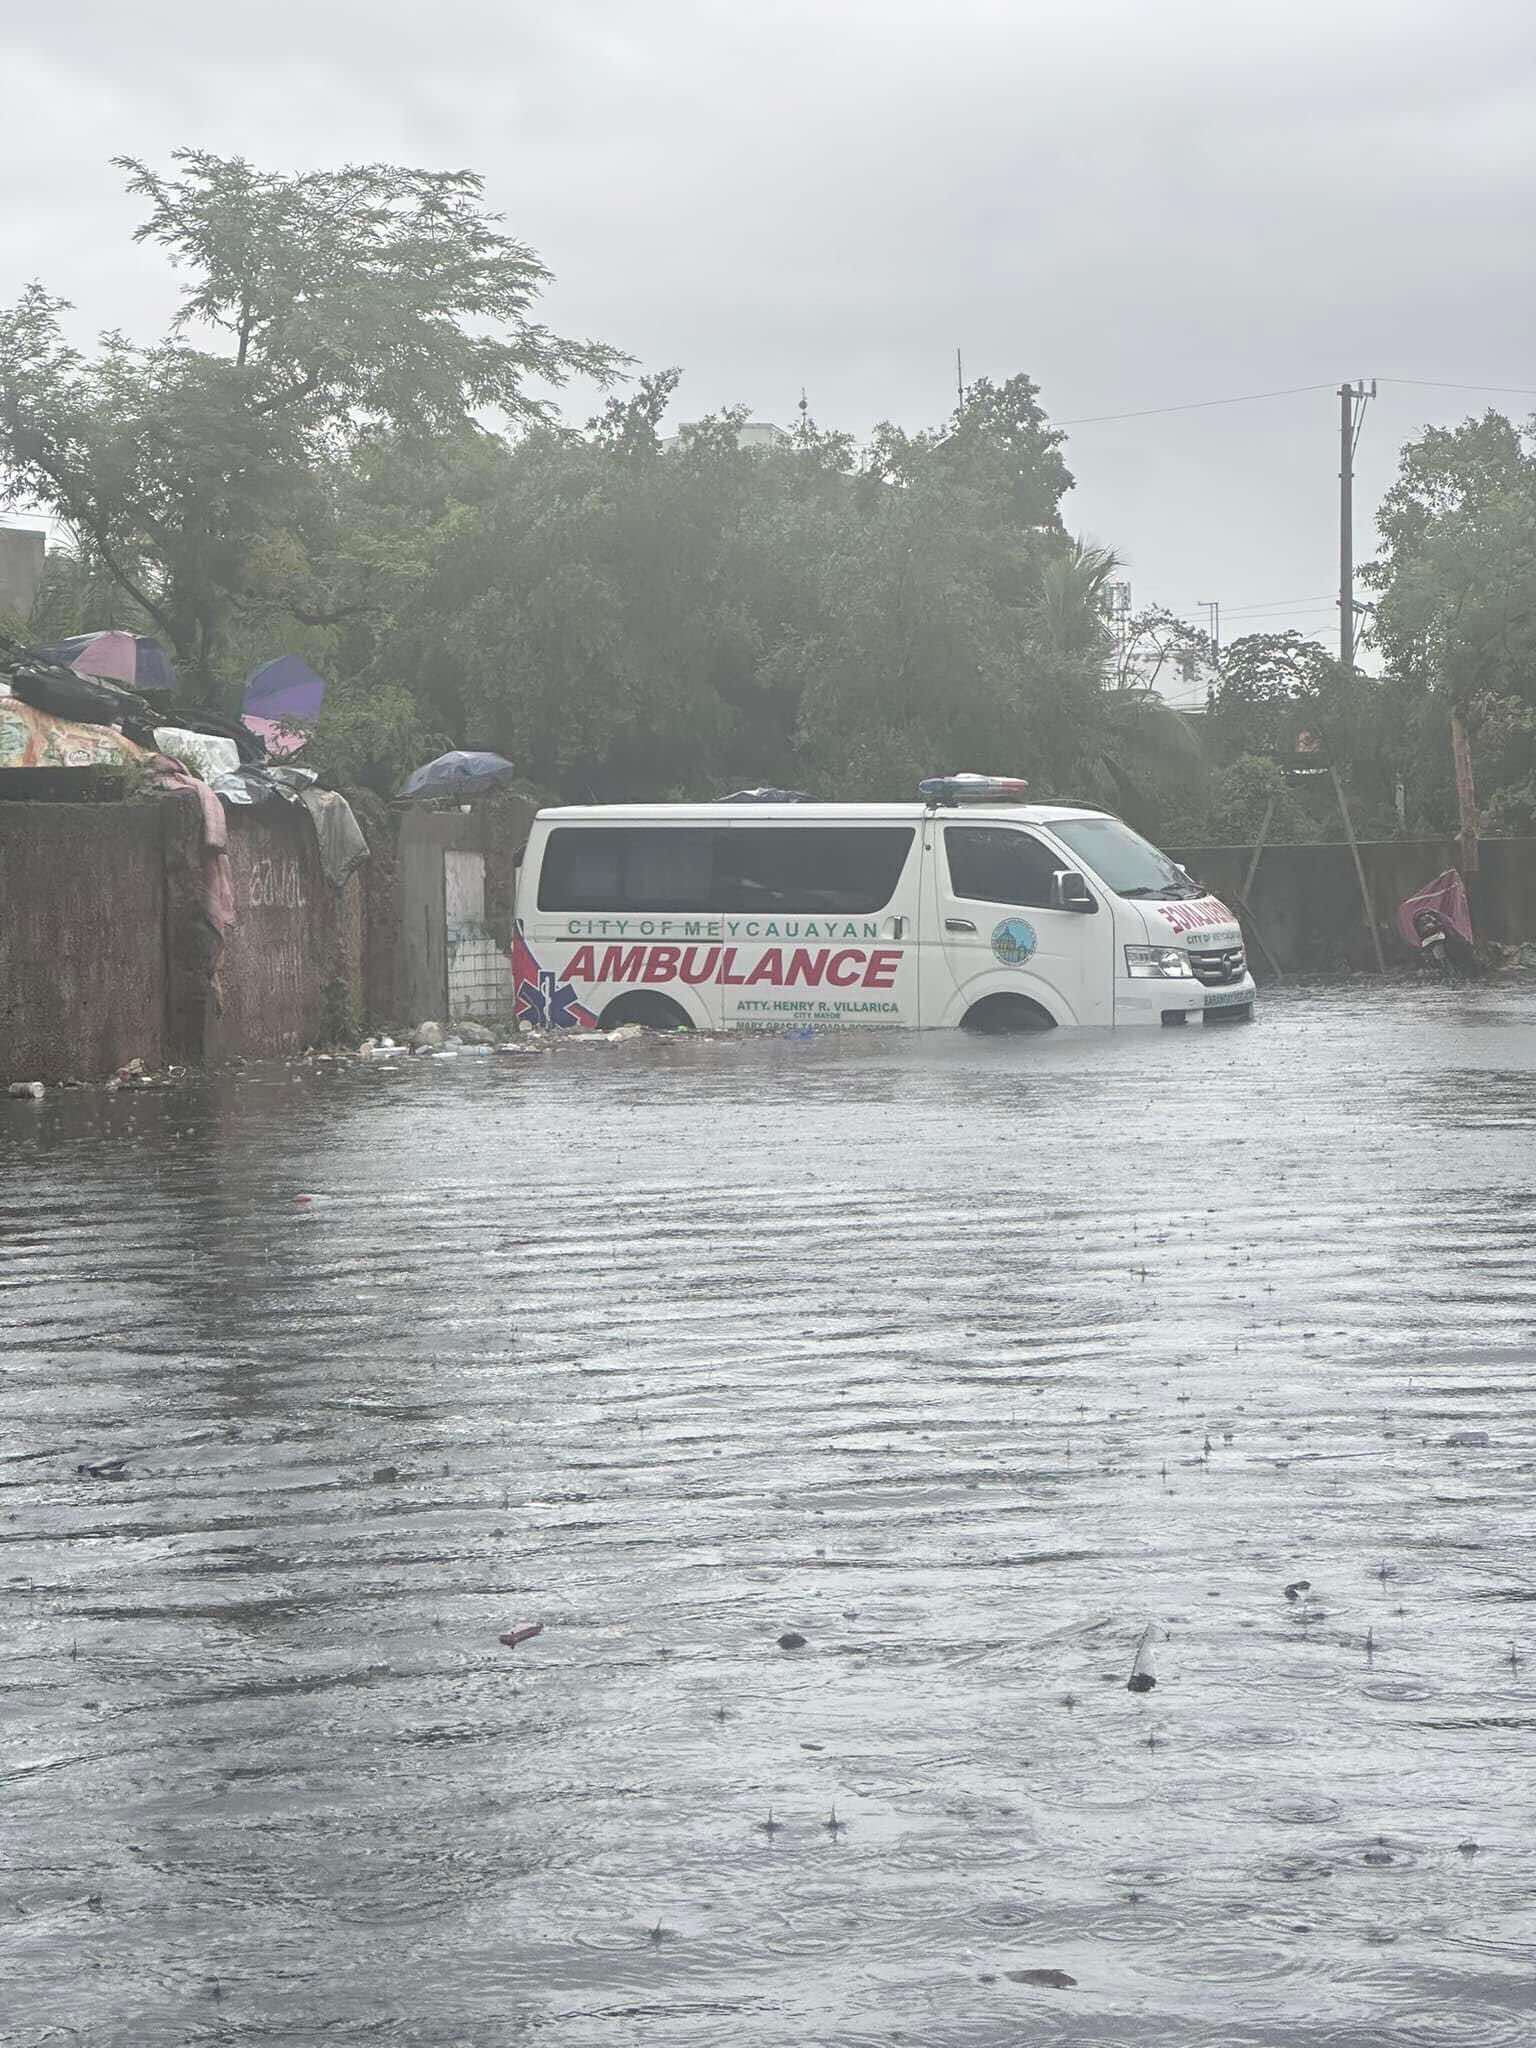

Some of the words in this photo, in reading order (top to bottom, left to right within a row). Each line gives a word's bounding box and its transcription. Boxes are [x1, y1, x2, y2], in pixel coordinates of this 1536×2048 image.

[567, 919, 628, 936] CITY
[639, 920, 672, 936] OF
[685, 921, 877, 938] MEYCAUAYAN
[558, 945, 904, 988] AMBULANCE
[736, 1001, 769, 1011] ATTY.
[773, 1001, 814, 1011] HENRY
[818, 1002, 830, 1012] R.
[834, 1002, 899, 1013] VILLARICA
